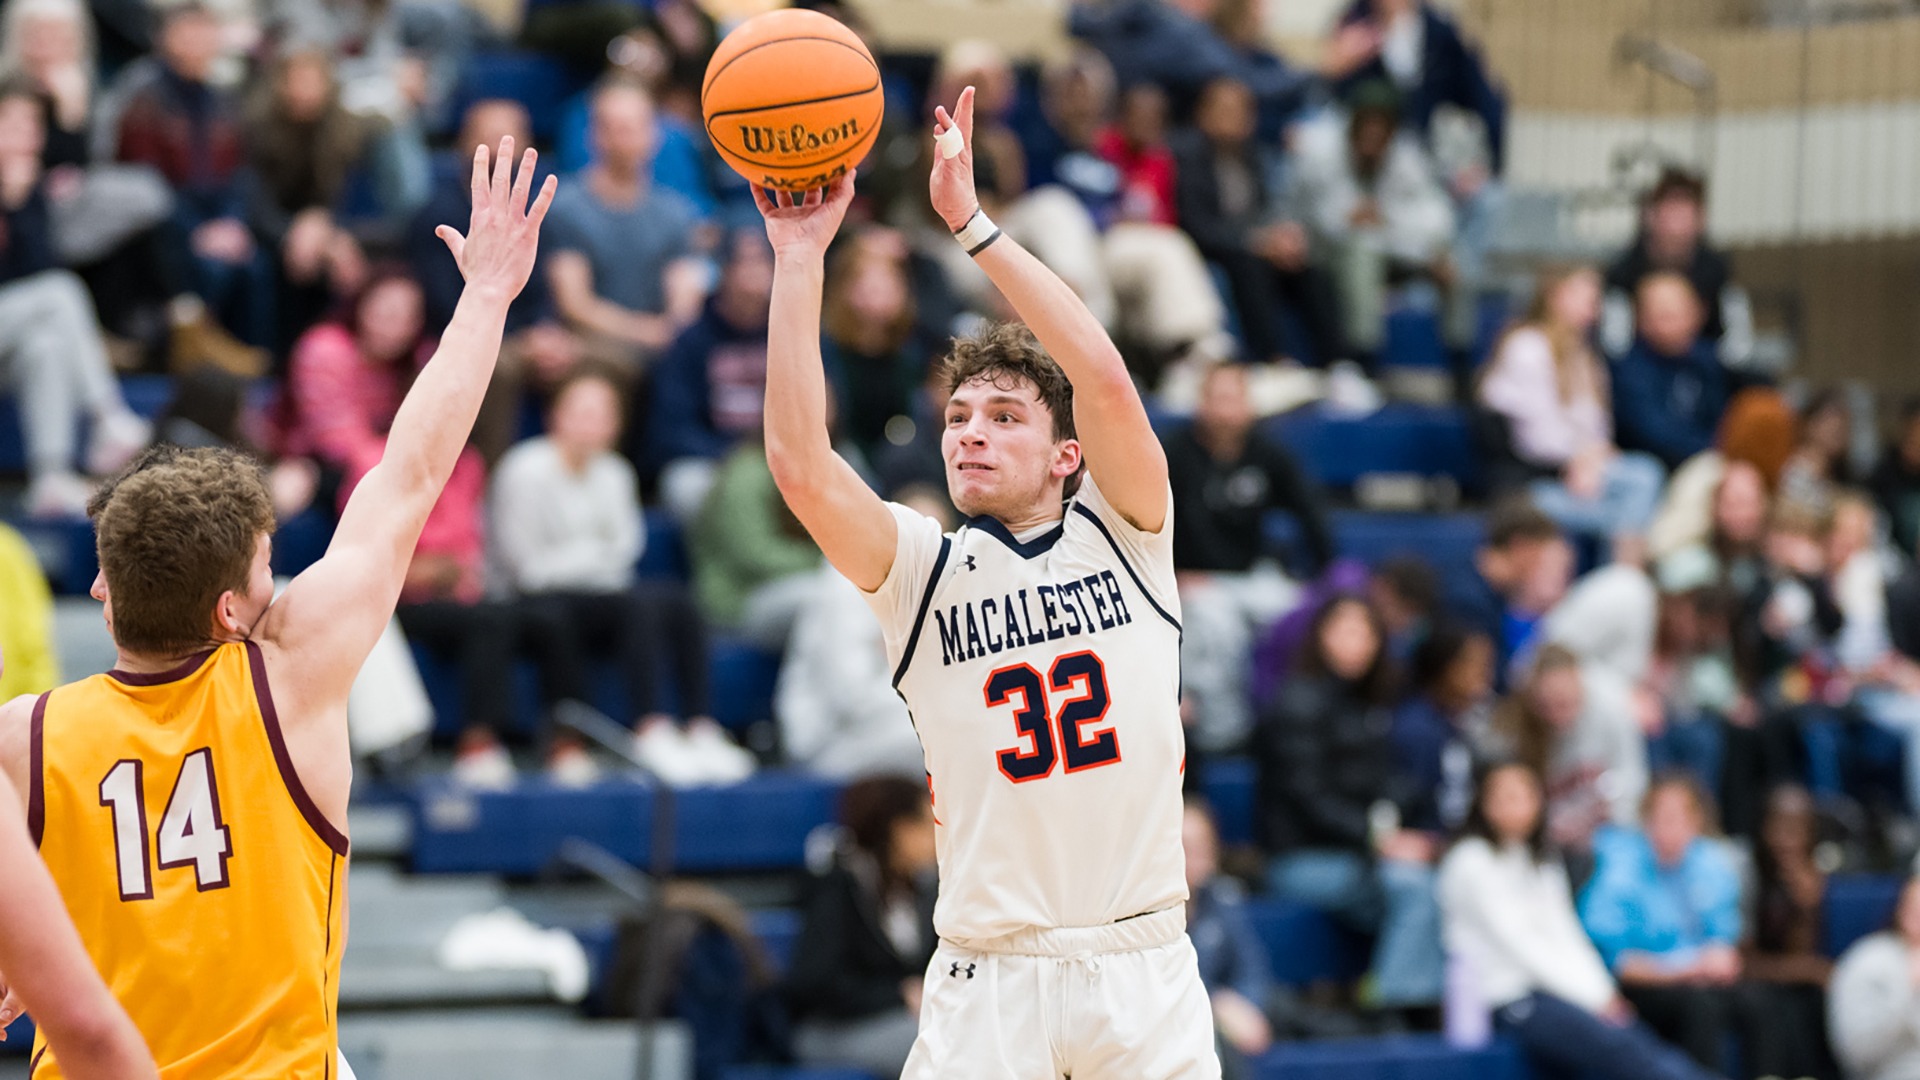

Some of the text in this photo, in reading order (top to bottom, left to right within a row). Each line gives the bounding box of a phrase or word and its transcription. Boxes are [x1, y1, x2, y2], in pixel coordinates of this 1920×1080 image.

[739, 118, 859, 154] Wilson
[934, 569, 1132, 666] MACALESTER
[983, 649, 1122, 784] 32
[98, 746, 234, 902] 14
